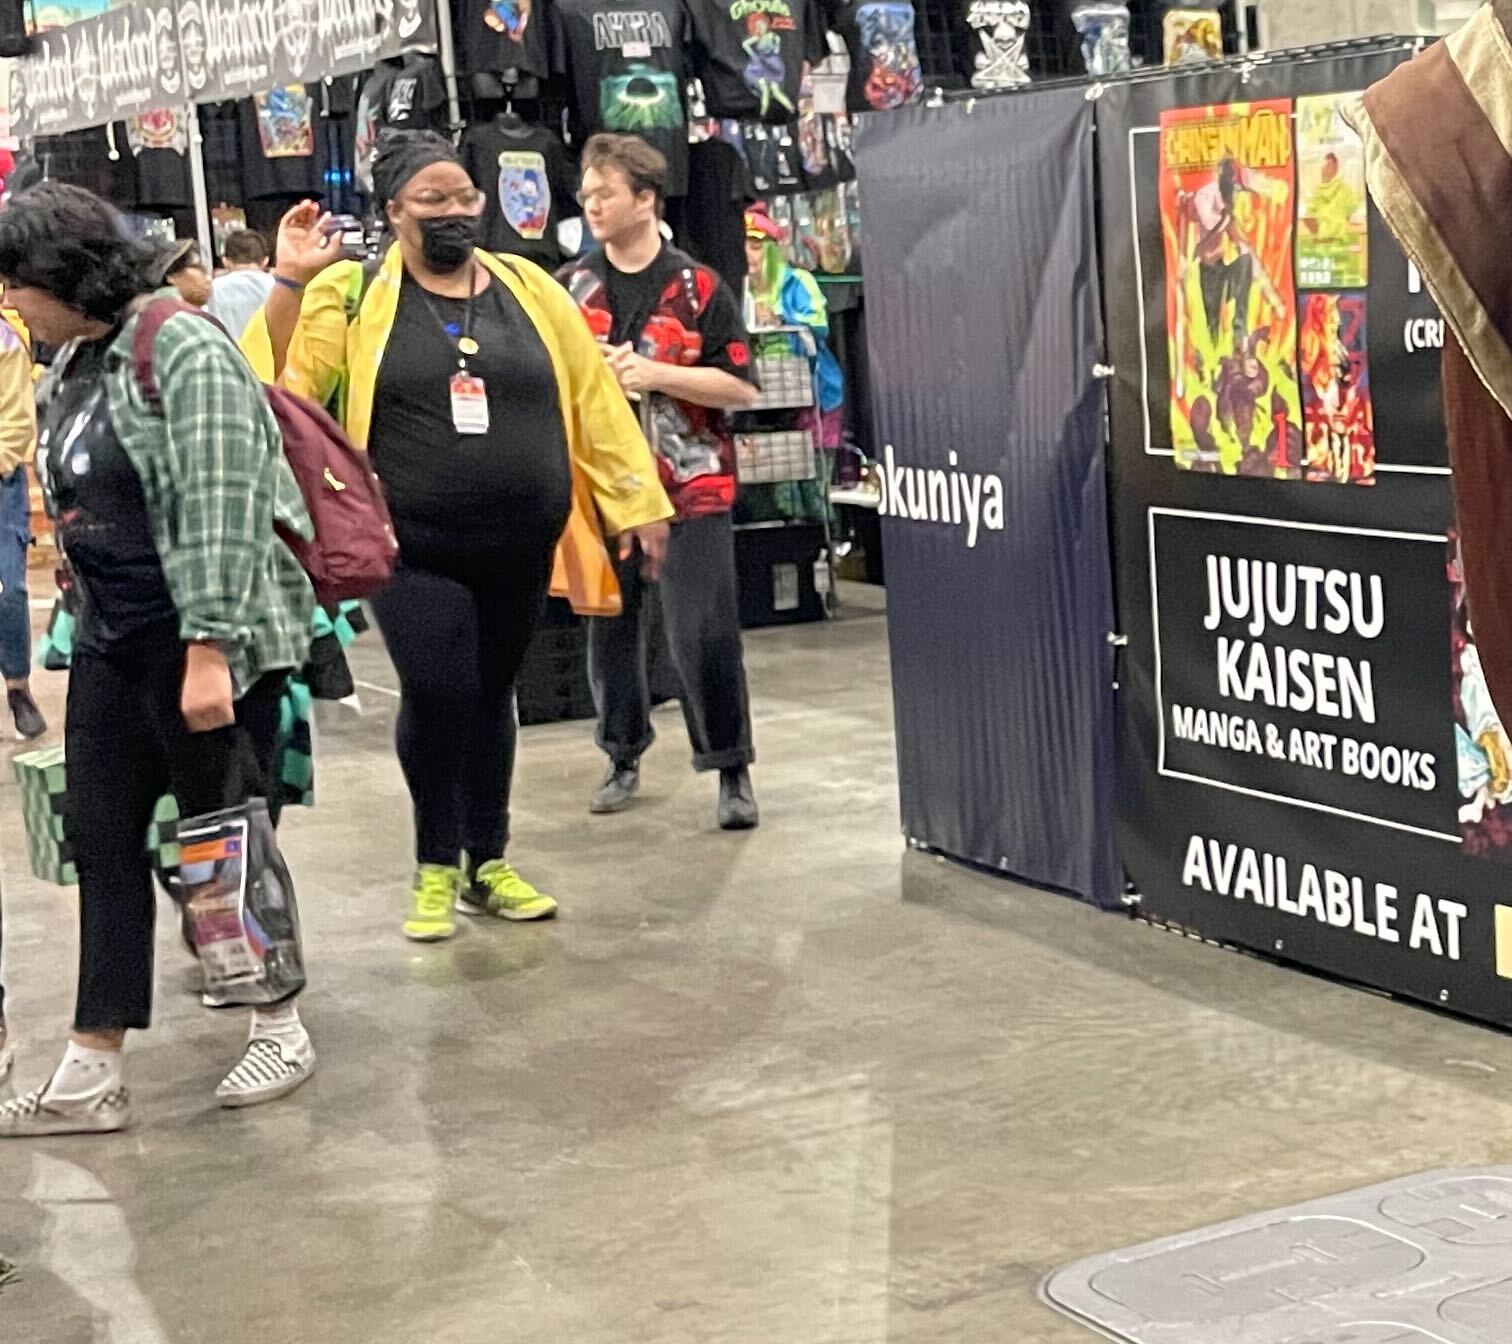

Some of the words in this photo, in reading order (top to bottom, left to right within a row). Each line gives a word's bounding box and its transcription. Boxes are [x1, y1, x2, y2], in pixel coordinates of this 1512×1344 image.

[1203, 554, 1385, 639] JUJUTSU
[1217, 638, 1377, 724] KAISEN
[1172, 706, 1263, 754] MANGA
[1265, 724, 1287, 760] &
[1288, 728, 1337, 772] ART
[1341, 741, 1437, 792] BOOKS
[1181, 835, 1400, 943] AVAILABLE
[1409, 893, 1468, 960] AT
